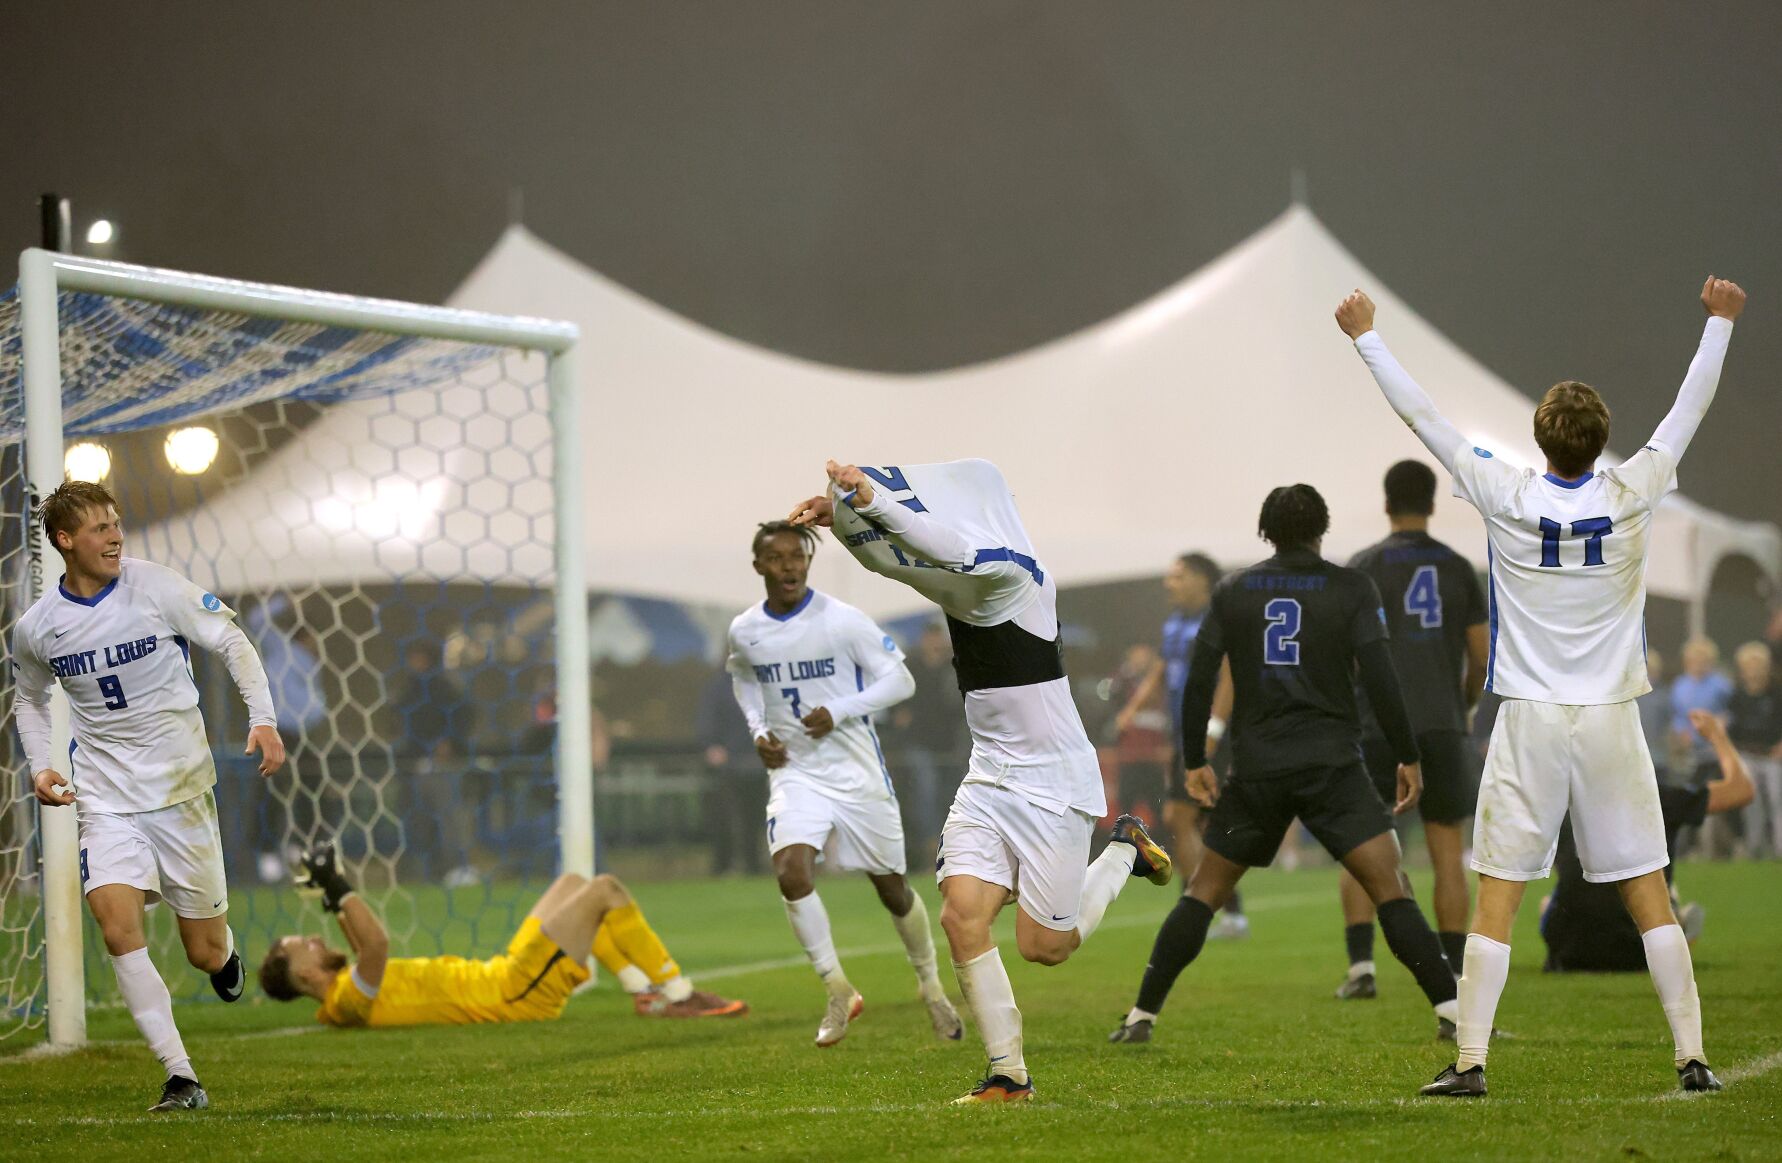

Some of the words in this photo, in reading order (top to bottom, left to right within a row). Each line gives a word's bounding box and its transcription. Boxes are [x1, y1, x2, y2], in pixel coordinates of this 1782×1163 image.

[1539, 516, 1613, 567] 17
[1404, 565, 1442, 628] 4
[1264, 598, 1302, 665] 2
[49, 650, 96, 677] SAINT
[104, 635, 157, 668] LOUIS
[788, 657, 835, 681] LOUIS
[96, 674, 128, 711] 9
[781, 687, 801, 719] 7
